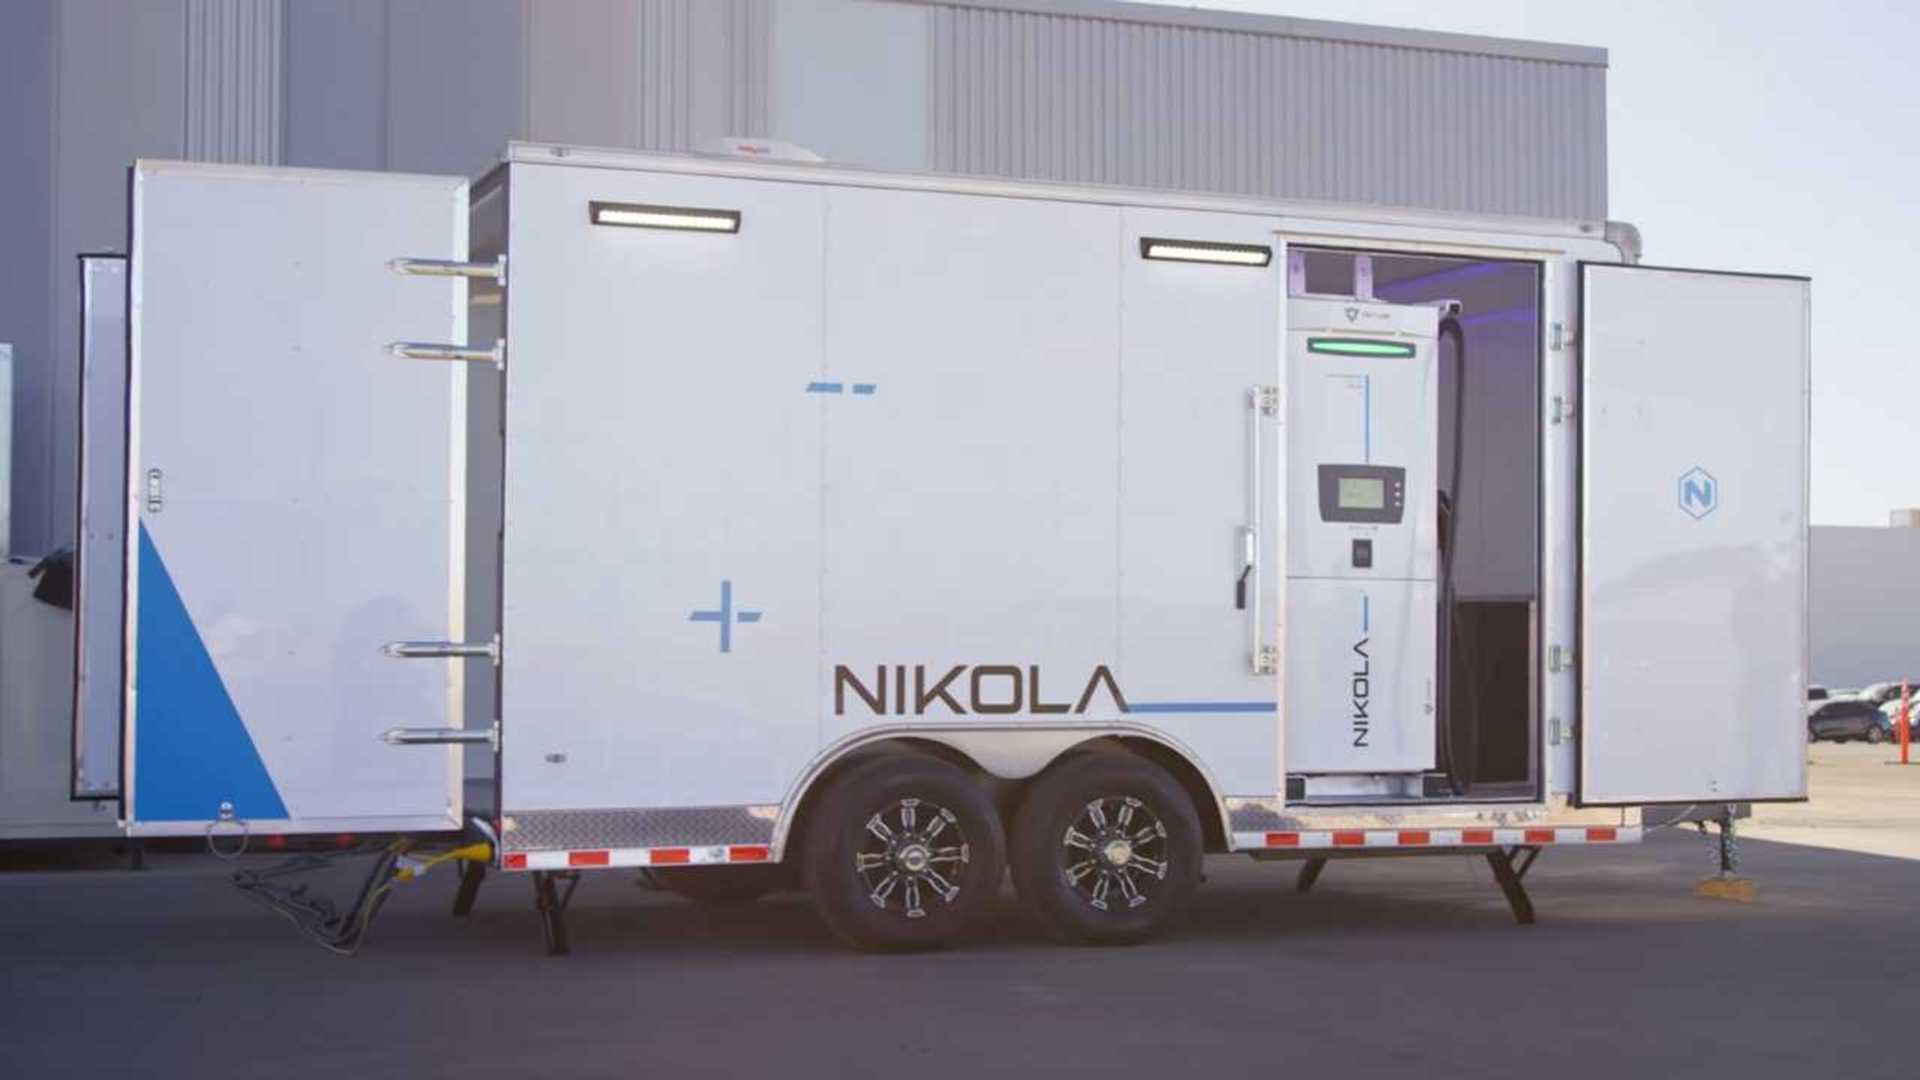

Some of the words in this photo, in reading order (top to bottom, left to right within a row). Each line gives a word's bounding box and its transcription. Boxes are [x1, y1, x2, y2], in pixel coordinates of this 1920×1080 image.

[1684, 479, 1711, 507] N
[834, 664, 1131, 715] NIKOLA
[1353, 638, 1369, 748] NIKOLA
